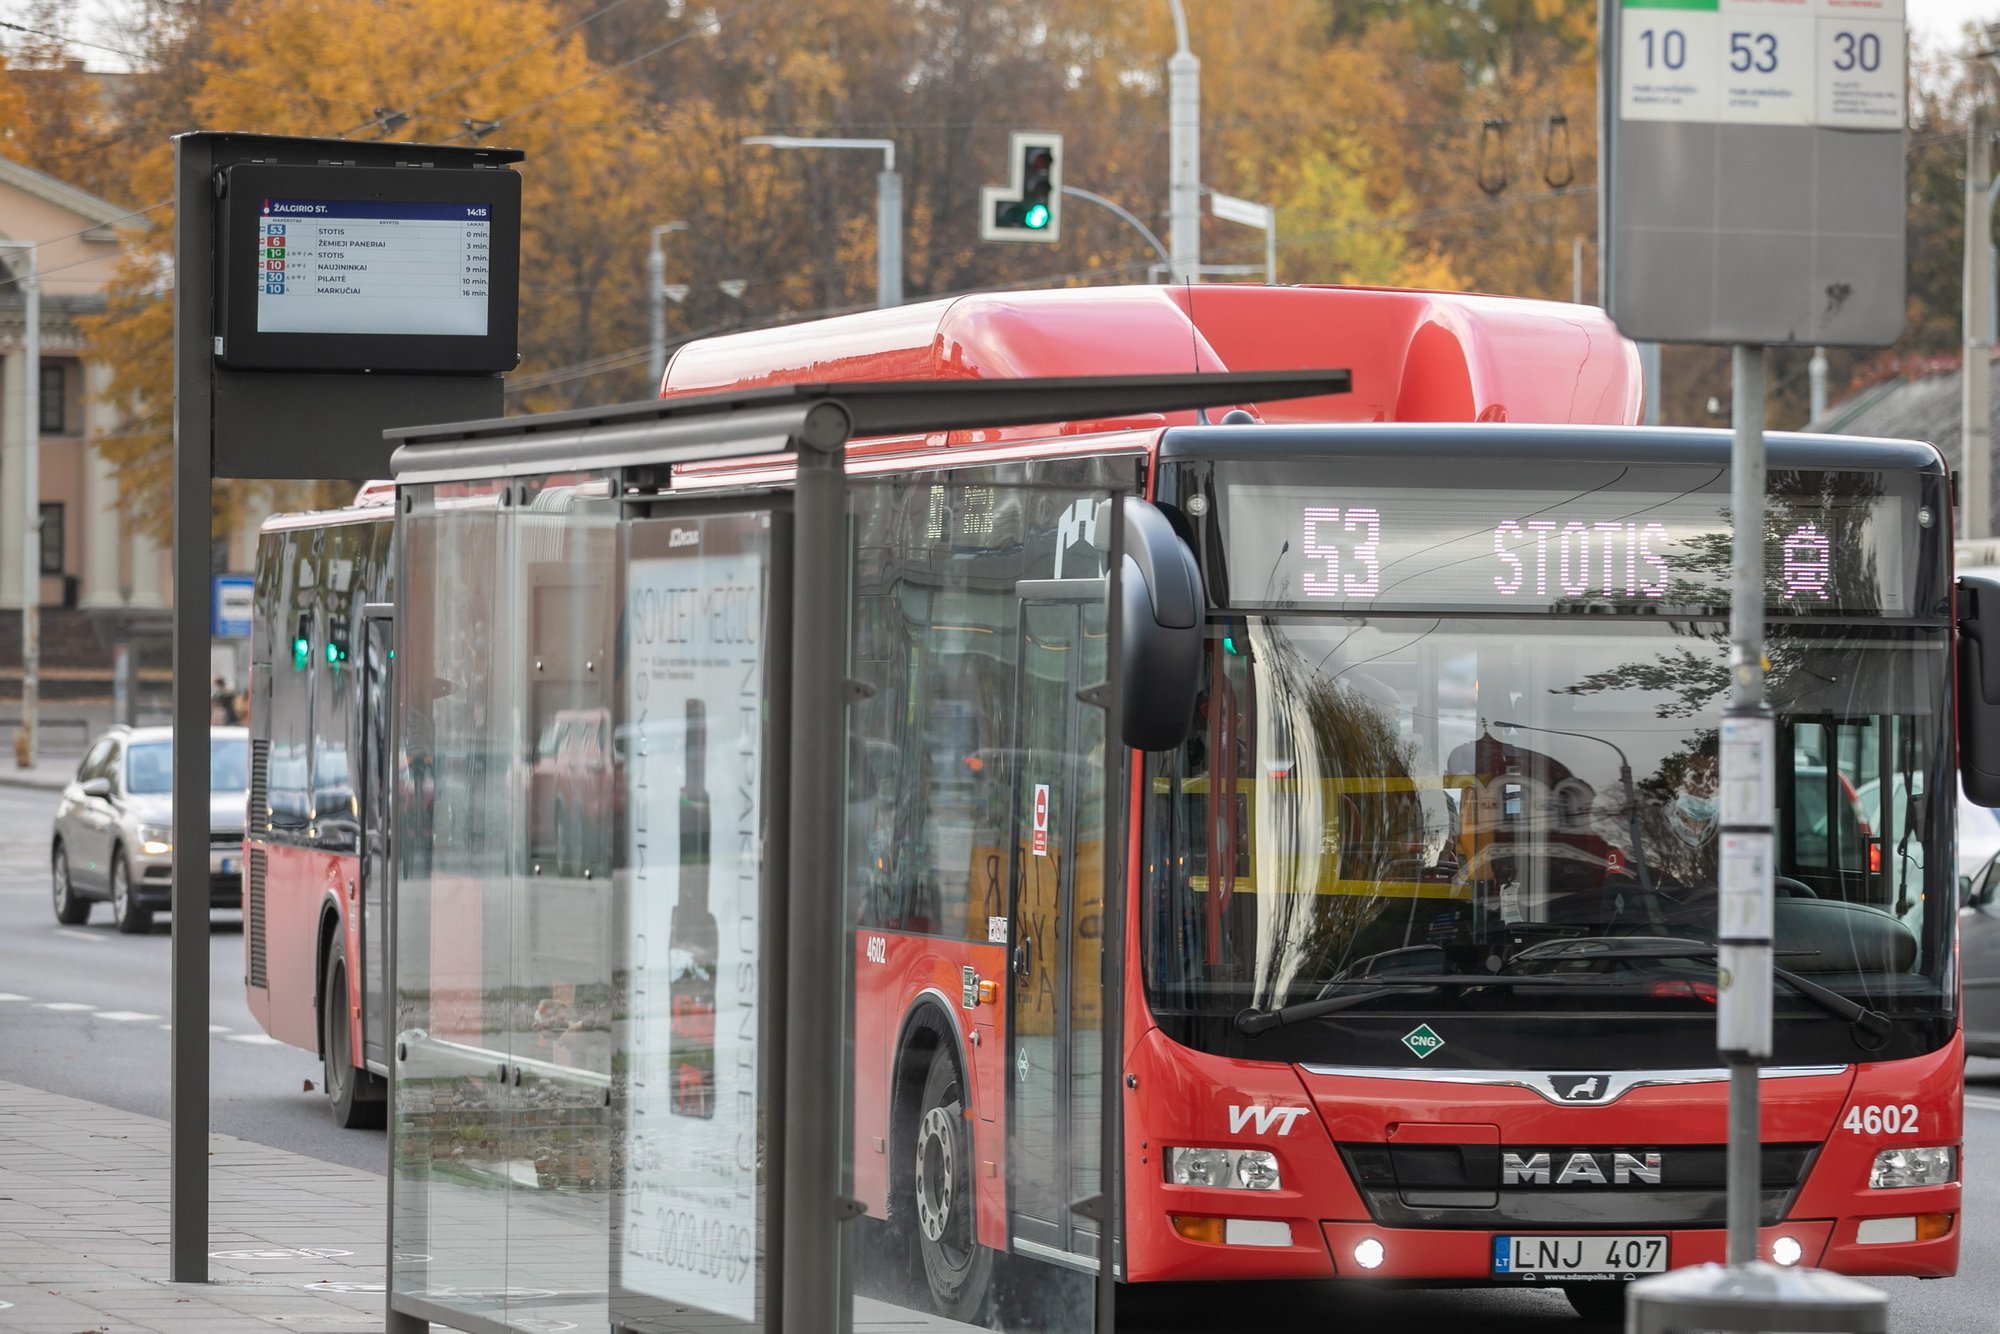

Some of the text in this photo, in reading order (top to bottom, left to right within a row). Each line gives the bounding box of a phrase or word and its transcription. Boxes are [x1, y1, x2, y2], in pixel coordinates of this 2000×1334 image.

[1639, 29, 1686, 71] 10
[1730, 32, 1778, 73] 53
[1833, 31, 1881, 72] 30
[274, 203, 314, 213] ŽALGIRIO
[467, 208, 487, 216] 14:15
[270, 225, 283, 234] 53
[272, 237, 280, 246] 6
[318, 239, 347, 247] ŽEMIEJI
[270, 261, 282, 270] 10
[269, 273, 283, 282] 30
[269, 285, 282, 293] 10
[317, 286, 361, 294] MARKUČIAI
[1303, 507, 1669, 597] 53 STOTIS
[867, 936, 886, 964] 4602
[1410, 1035, 1436, 1047] CNG
[1843, 1104, 1919, 1135] 4602
[1502, 1152, 1662, 1185] MAN
[1495, 1240, 1662, 1269] LT LNJ 407
[1544, 1272, 1616, 1282] www.adampolis.lt
